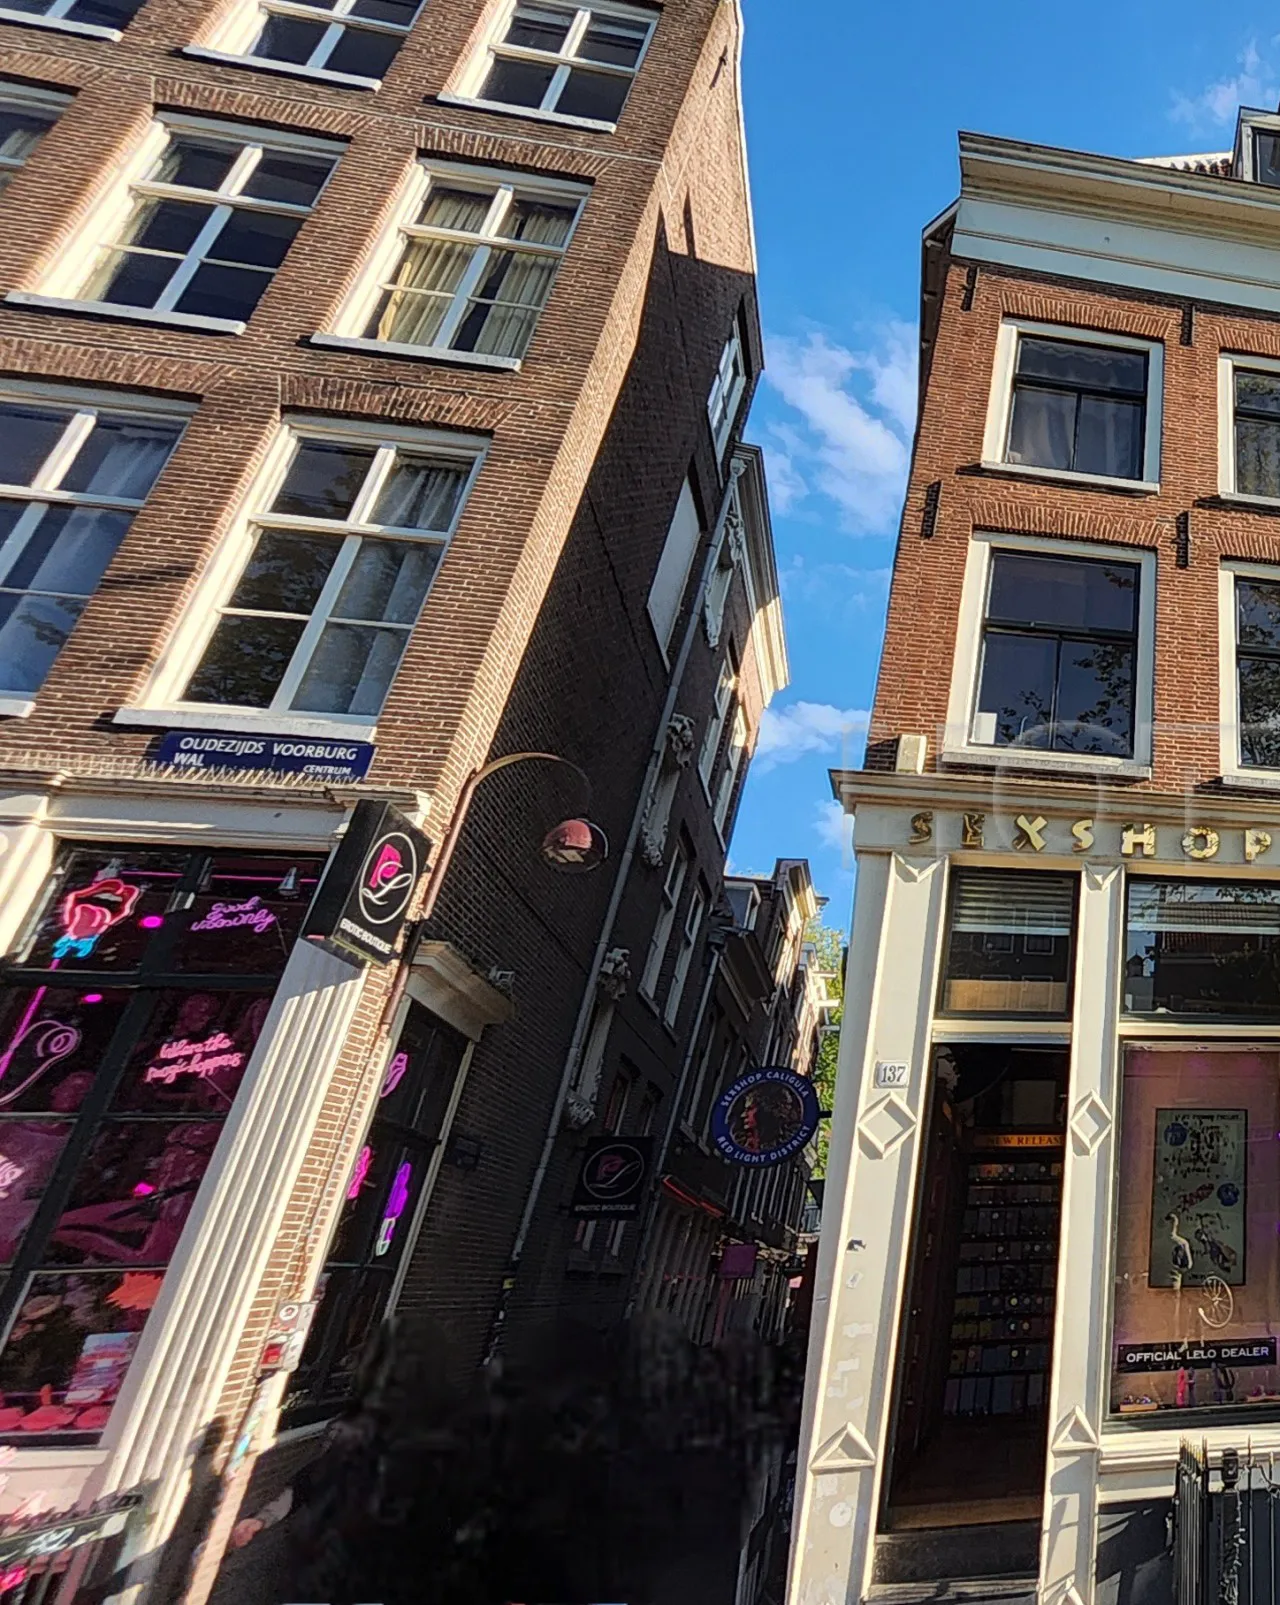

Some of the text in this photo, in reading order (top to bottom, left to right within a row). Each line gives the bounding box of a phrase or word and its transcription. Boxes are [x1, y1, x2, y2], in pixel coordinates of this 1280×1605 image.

[173, 752, 205, 767] WAL
[180, 737, 358, 761] OUDEZIJDS VOORBURG
[303, 764, 353, 775] CENTRUM
[908, 810, 1274, 862] SEXSHOP
[881, 1065, 906, 1083] 137
[721, 1071, 809, 1107] SEXSHOP CALIGULA
[717, 1125, 811, 1163] RED LIGHT DISTRICT
[1126, 1346, 1270, 1363] OFFICIAL LELO DEALER
